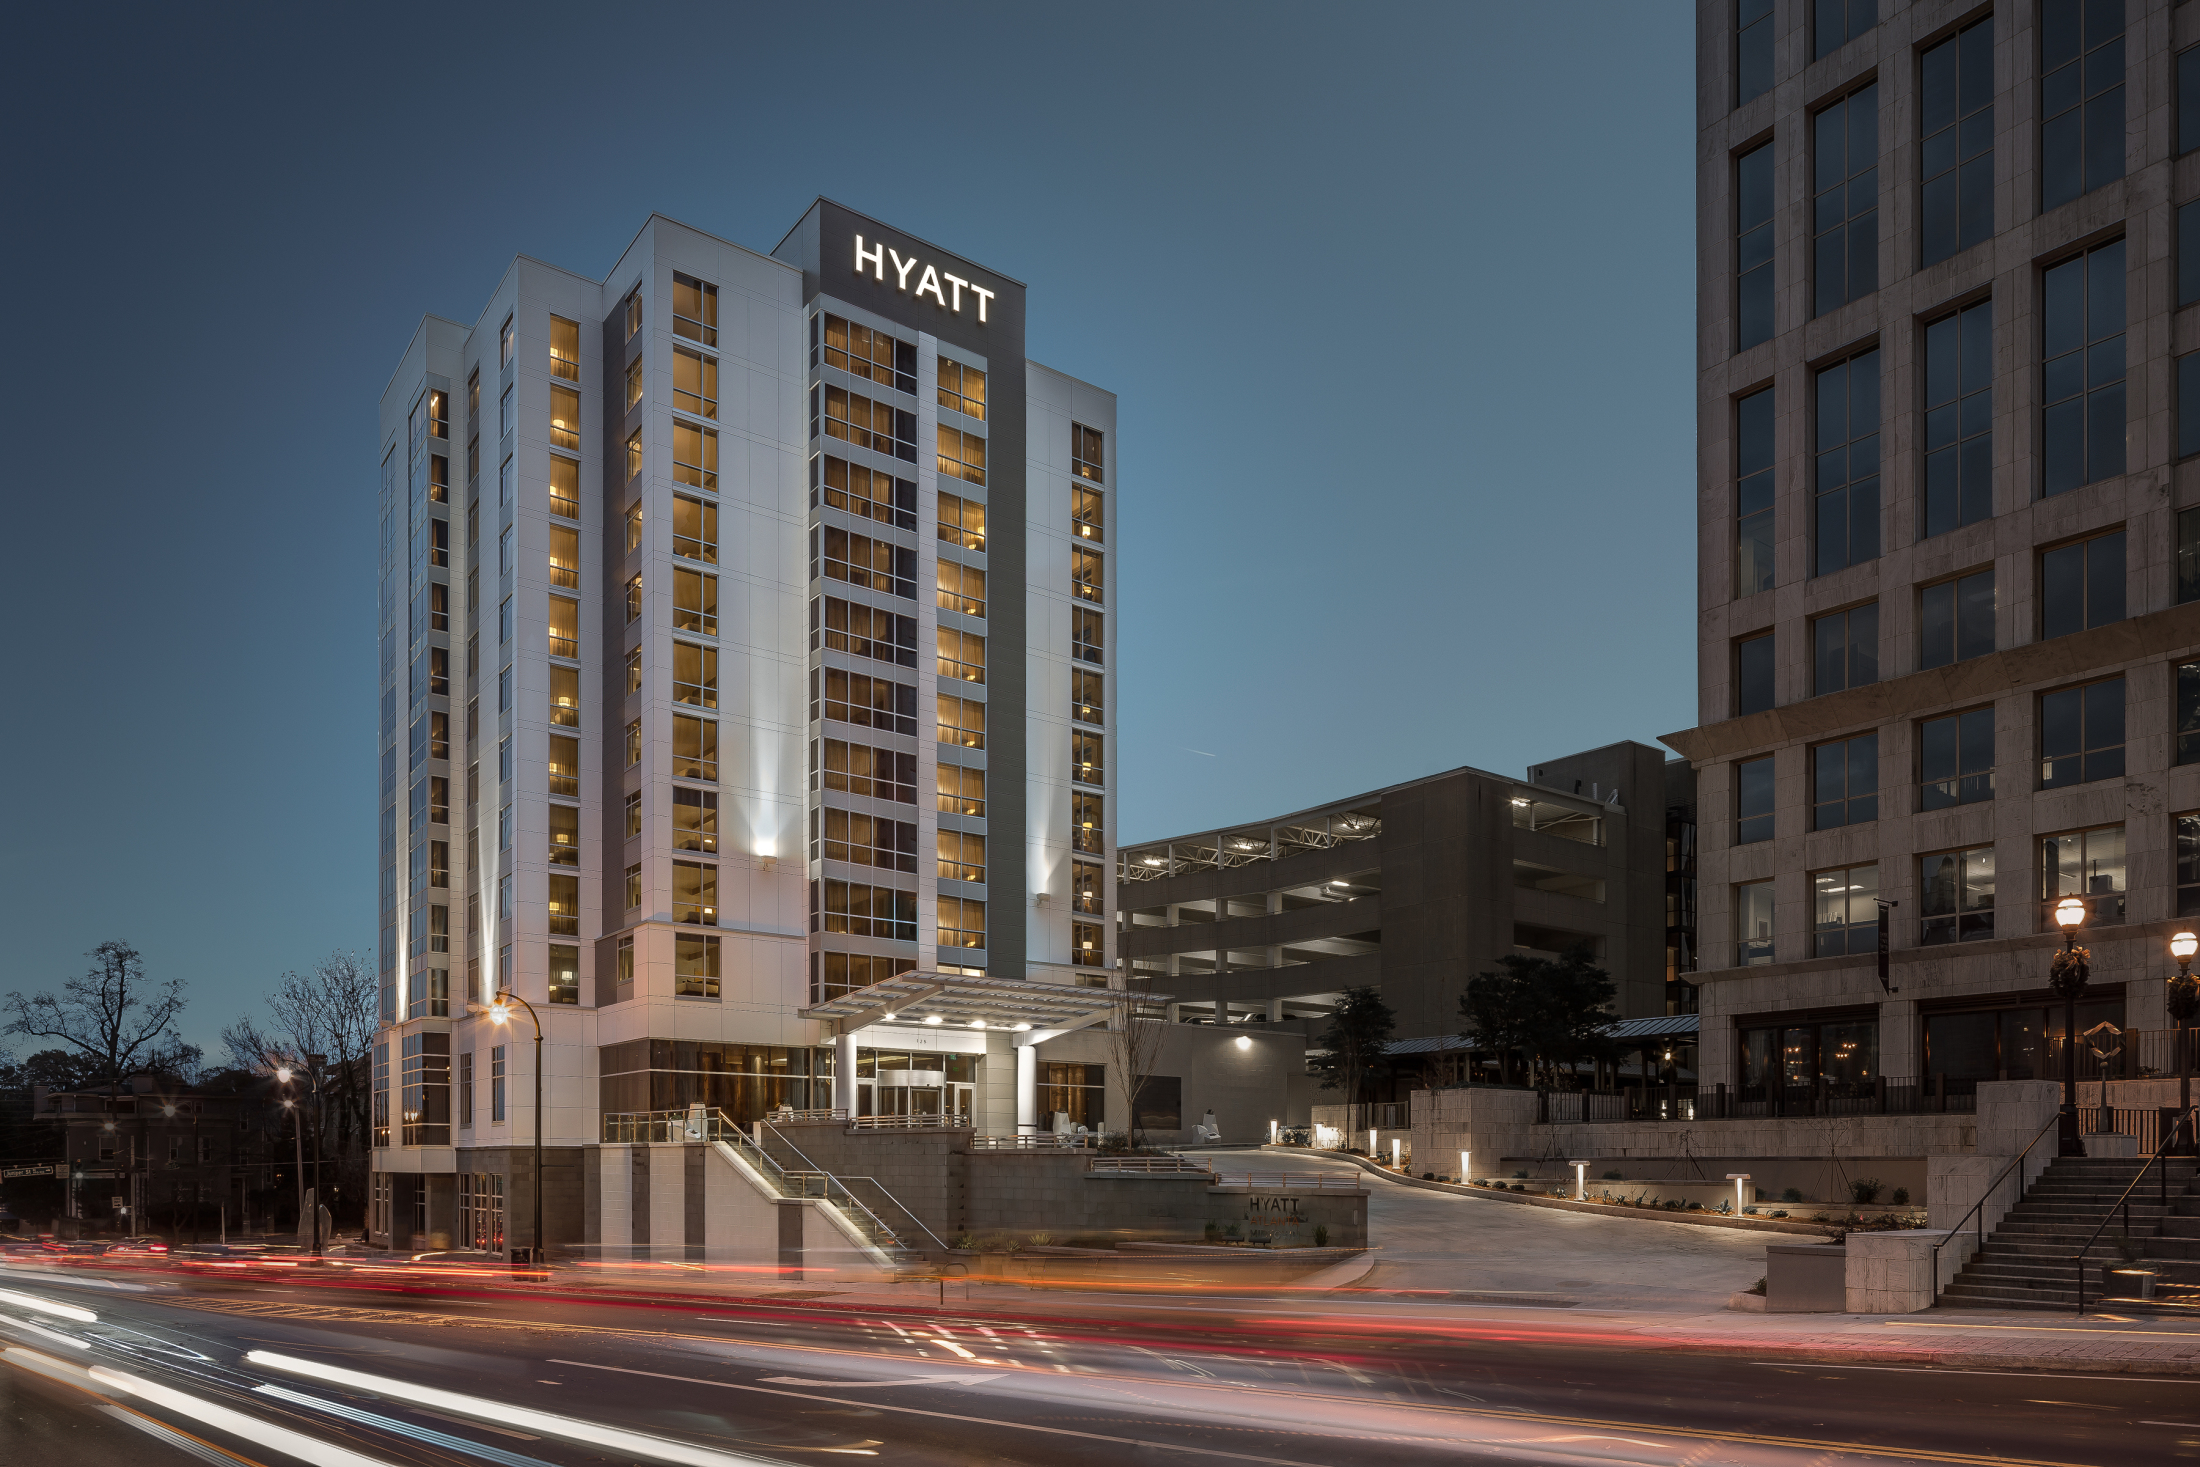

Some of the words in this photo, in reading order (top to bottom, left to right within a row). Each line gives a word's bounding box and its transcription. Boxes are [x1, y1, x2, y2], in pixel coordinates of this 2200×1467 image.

[855, 234, 995, 324] HYATT
[1250, 1197, 1300, 1211] HYATT
[1250, 1215, 1300, 1227] ATLANTA
